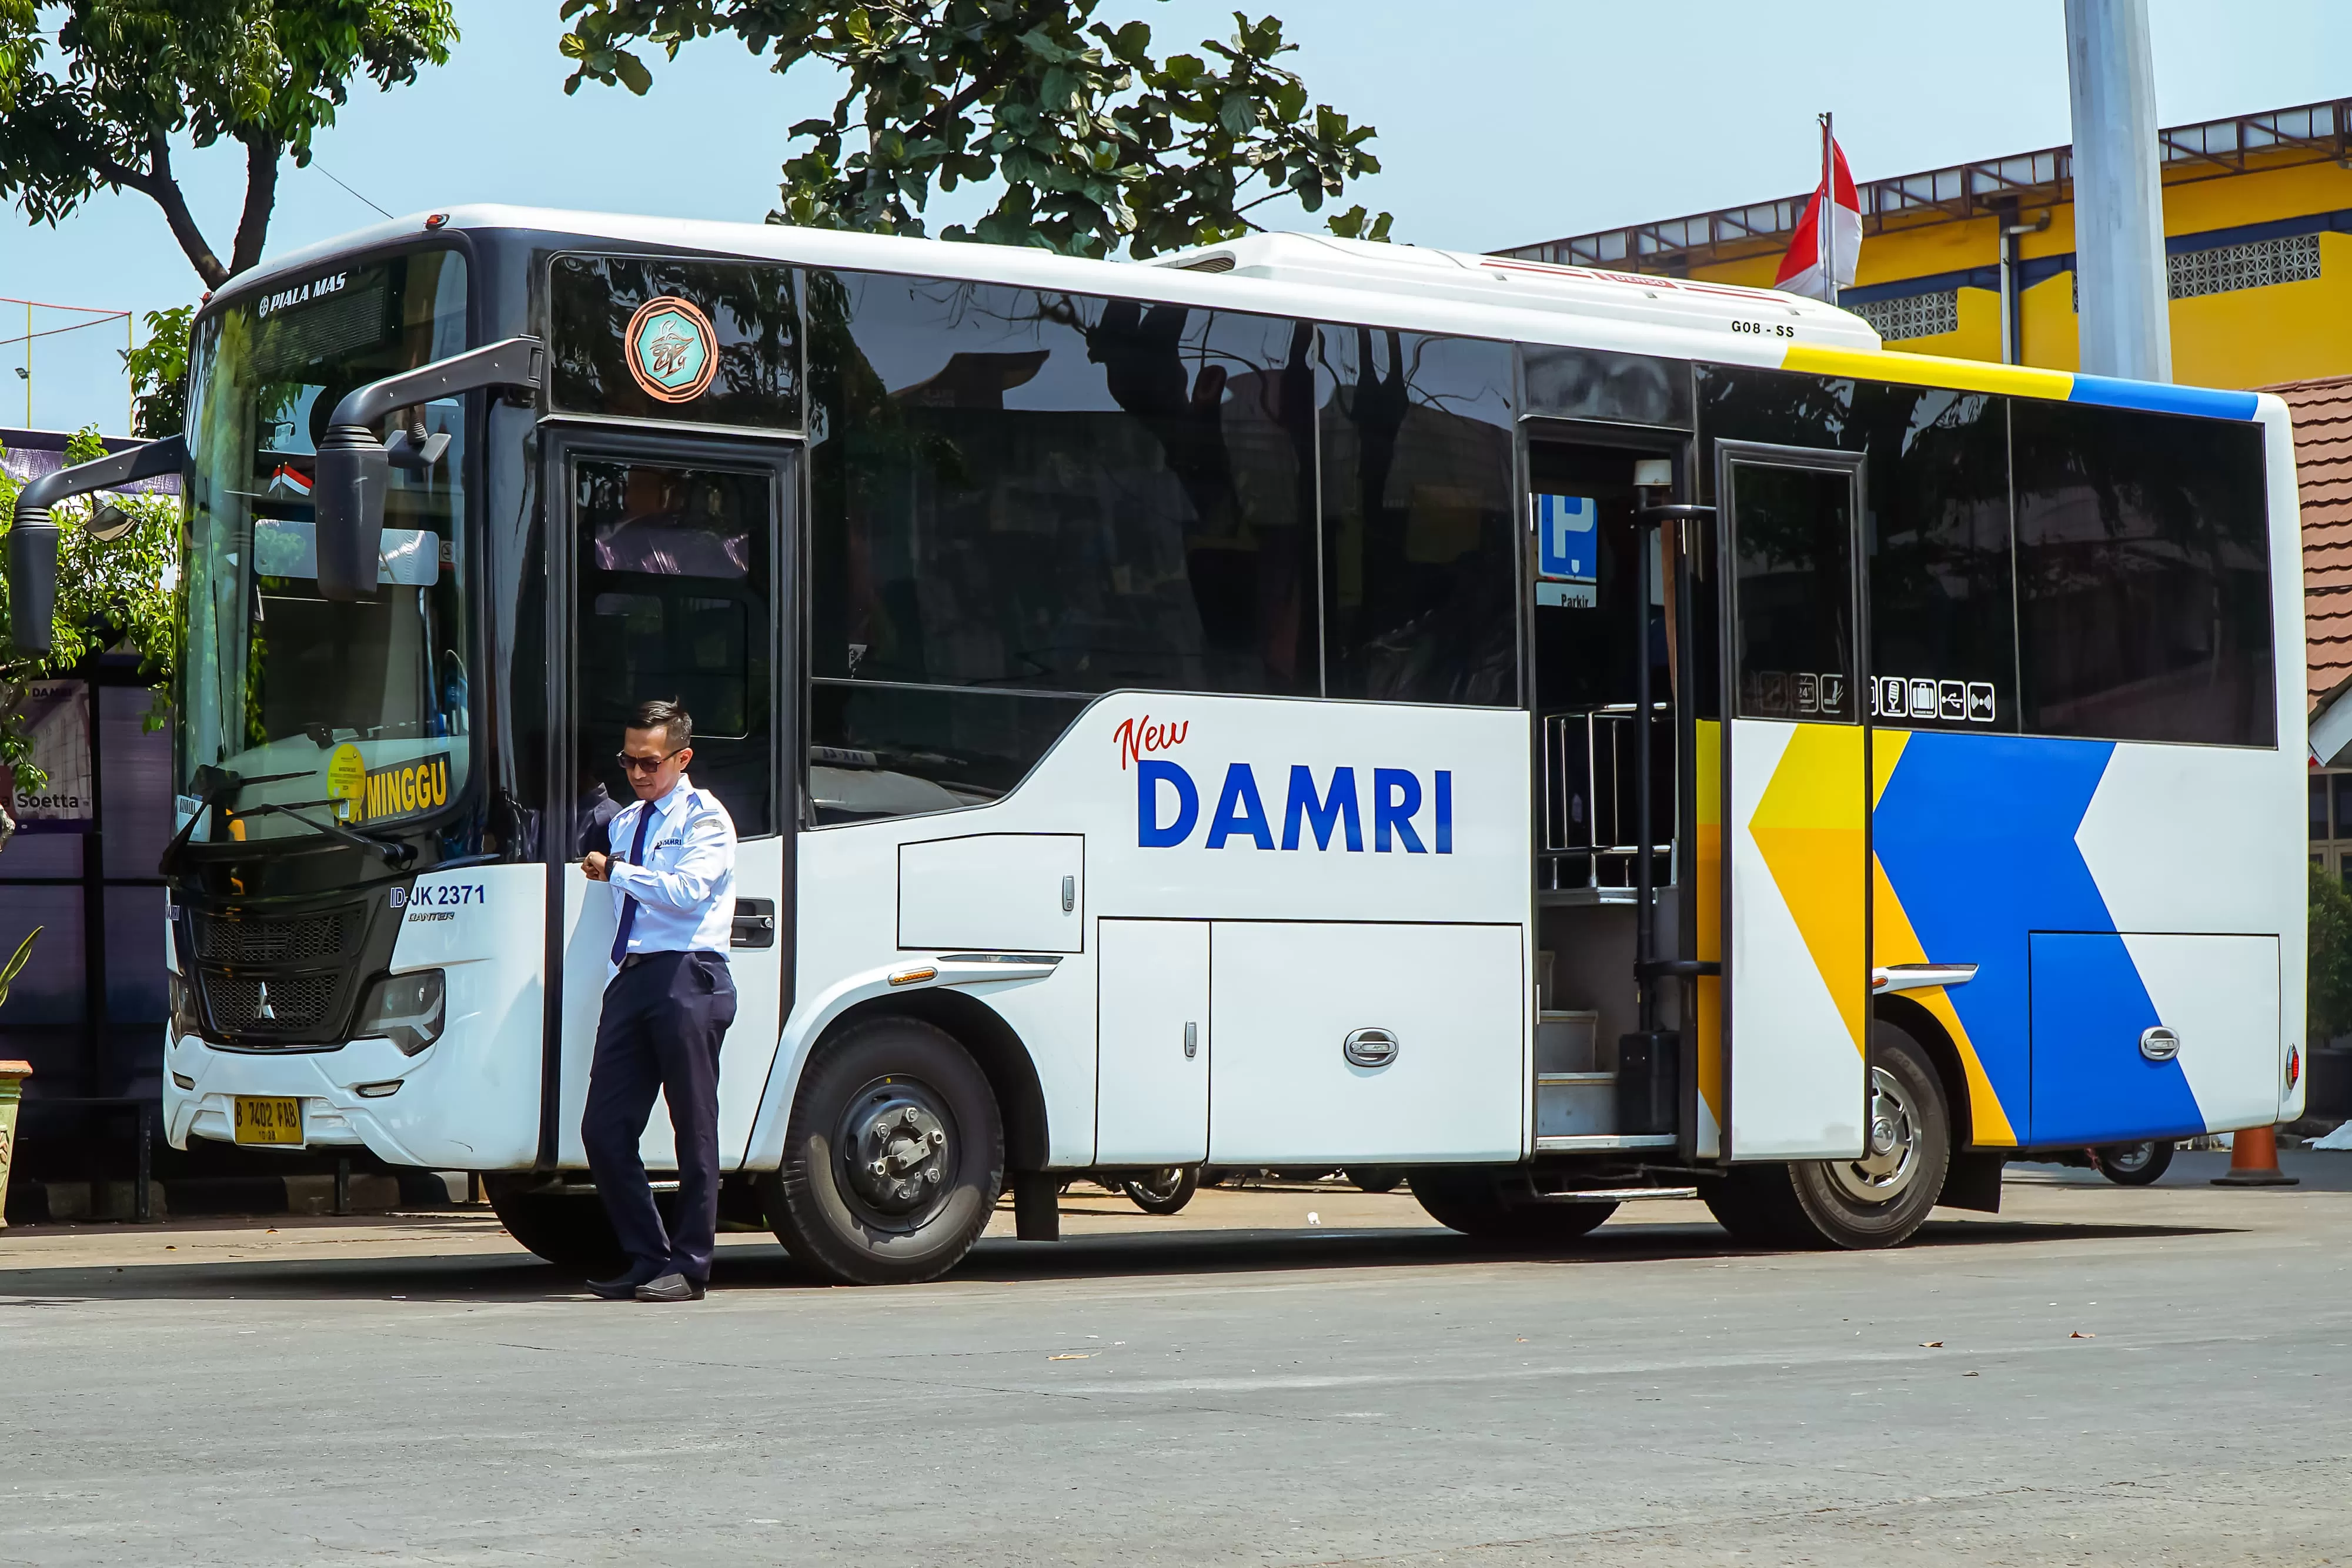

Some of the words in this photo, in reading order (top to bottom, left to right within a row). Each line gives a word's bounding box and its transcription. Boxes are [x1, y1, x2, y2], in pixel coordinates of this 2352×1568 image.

[269, 284, 309, 312] PIALA
[313, 272, 347, 298] MAS
[1613, 275, 1666, 287] DENSO
[1732, 320, 1760, 334] G08
[1776, 325, 1794, 337] SS
[1553, 494, 1594, 559] P
[1561, 594, 1589, 607] Parkir
[1113, 715, 1188, 770] New
[17, 793, 78, 808] Soetta
[366, 757, 447, 819] MINGGU
[1138, 760, 1452, 854] DAMRI
[437, 884, 485, 905] 2371
[236, 1102, 242, 1128] B
[249, 1102, 273, 1128] 7402
